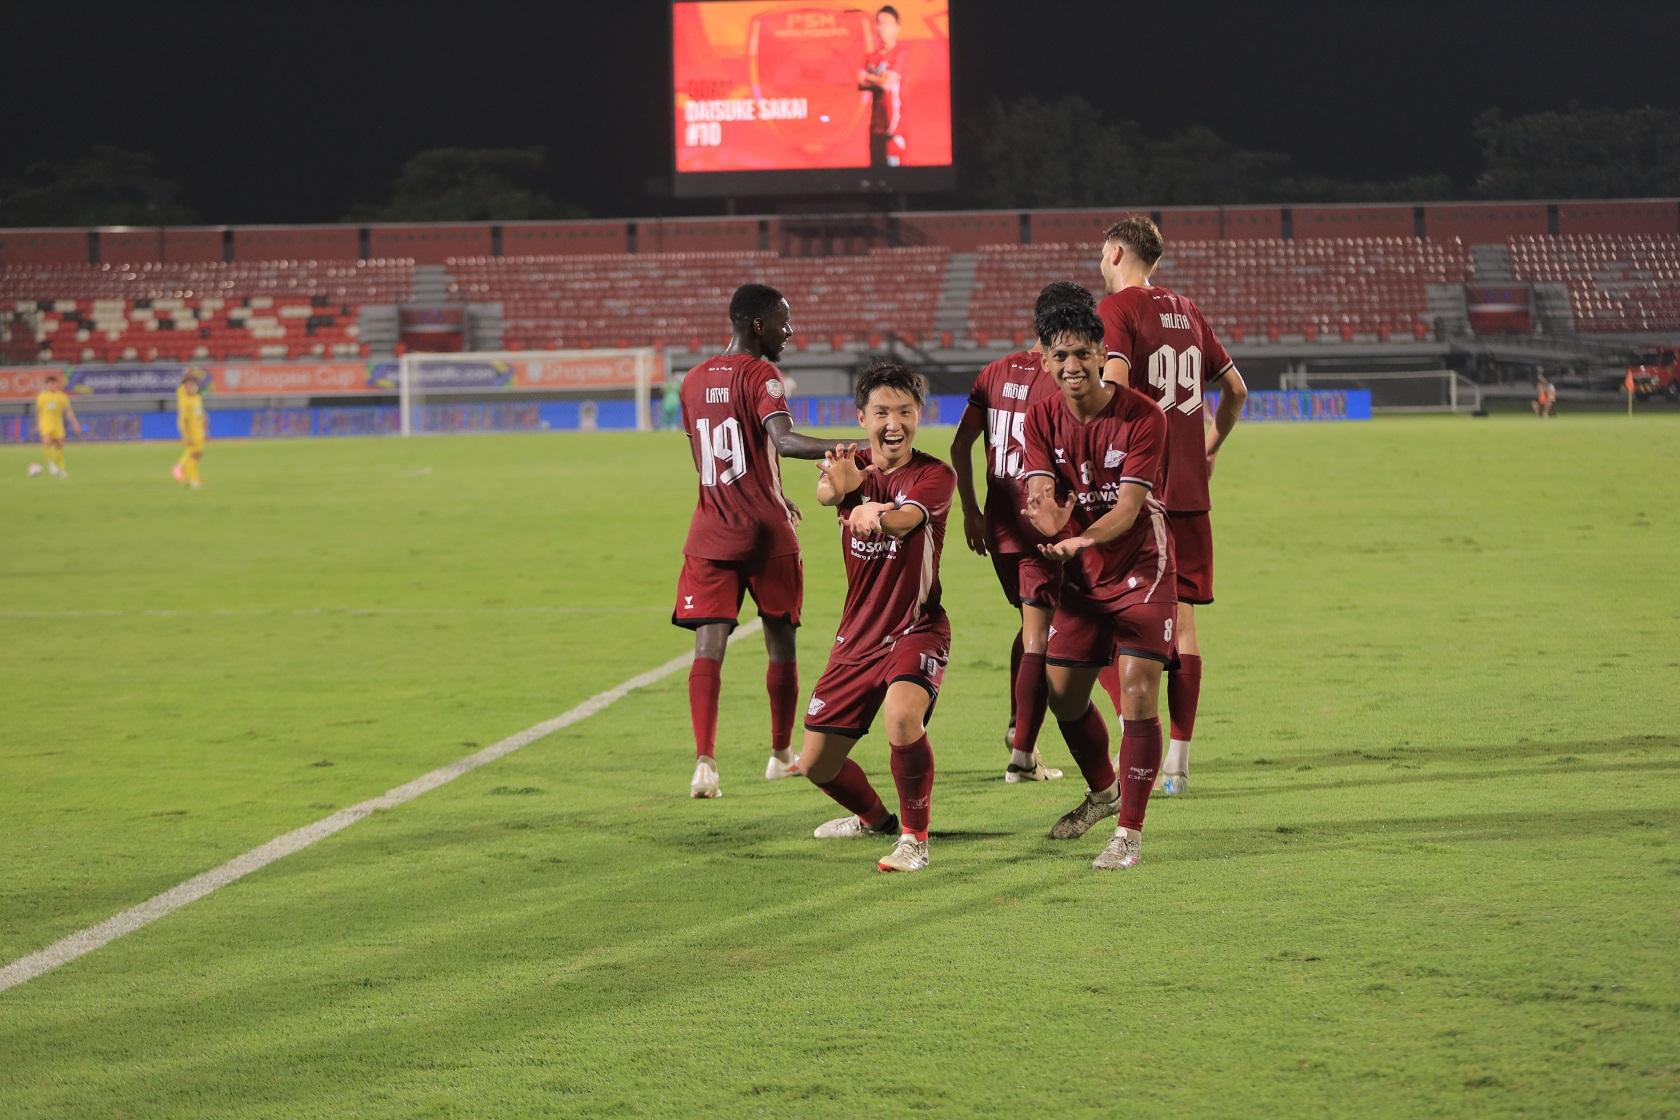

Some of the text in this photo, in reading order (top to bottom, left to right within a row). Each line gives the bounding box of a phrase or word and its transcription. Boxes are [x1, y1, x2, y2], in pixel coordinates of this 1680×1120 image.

[684, 97, 808, 121] DAISUKE SAKAI
[685, 122, 722, 146] #10
[1002, 382, 1029, 400] AKBAR
[1148, 344, 1203, 416] 99
[706, 387, 729, 403] LATYR
[696, 417, 747, 487] 19
[987, 408, 1026, 479] 45
[1081, 460, 1094, 485] 8
[1164, 618, 1173, 642] 8
